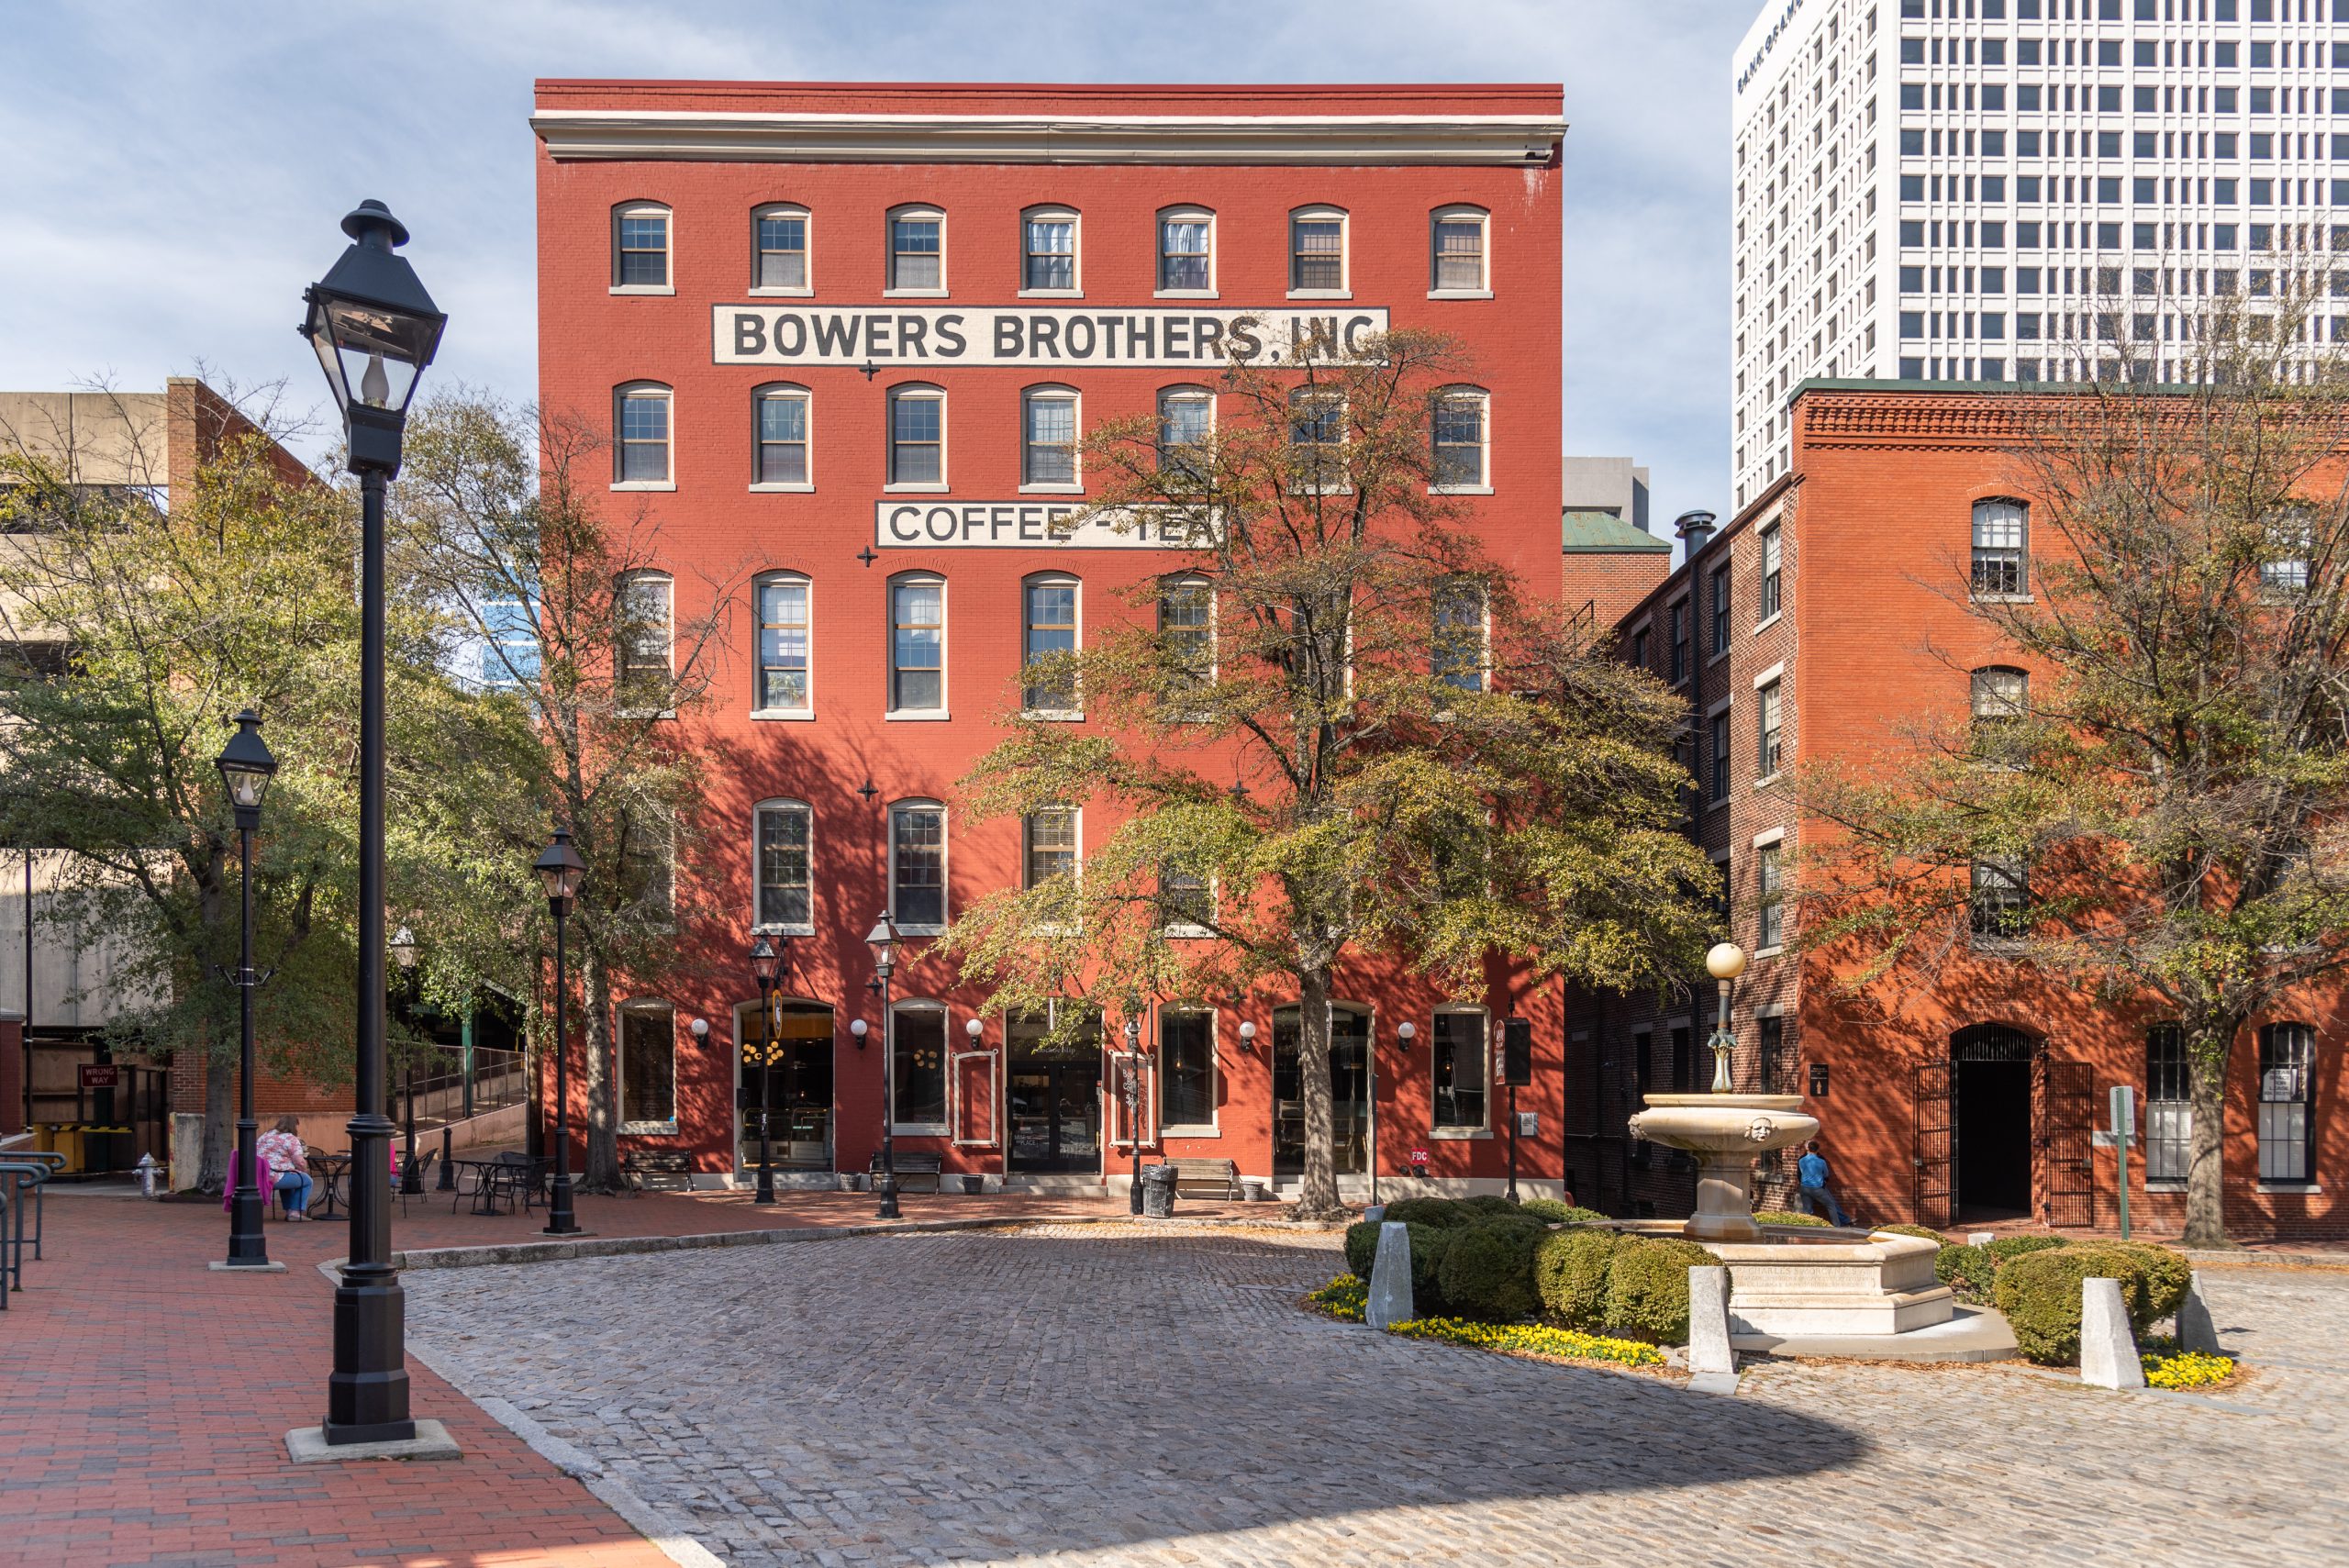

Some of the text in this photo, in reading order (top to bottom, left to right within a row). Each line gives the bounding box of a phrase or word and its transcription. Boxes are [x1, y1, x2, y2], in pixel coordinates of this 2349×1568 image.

[1738, 47, 1765, 95] BANK
[1765, 24, 1779, 54] OF
[734, 313, 967, 358] BOWERS
[1291, 316, 1375, 360] INC
[889, 506, 1072, 541] COFFEE
[1412, 1151, 1428, 1161] FDC
